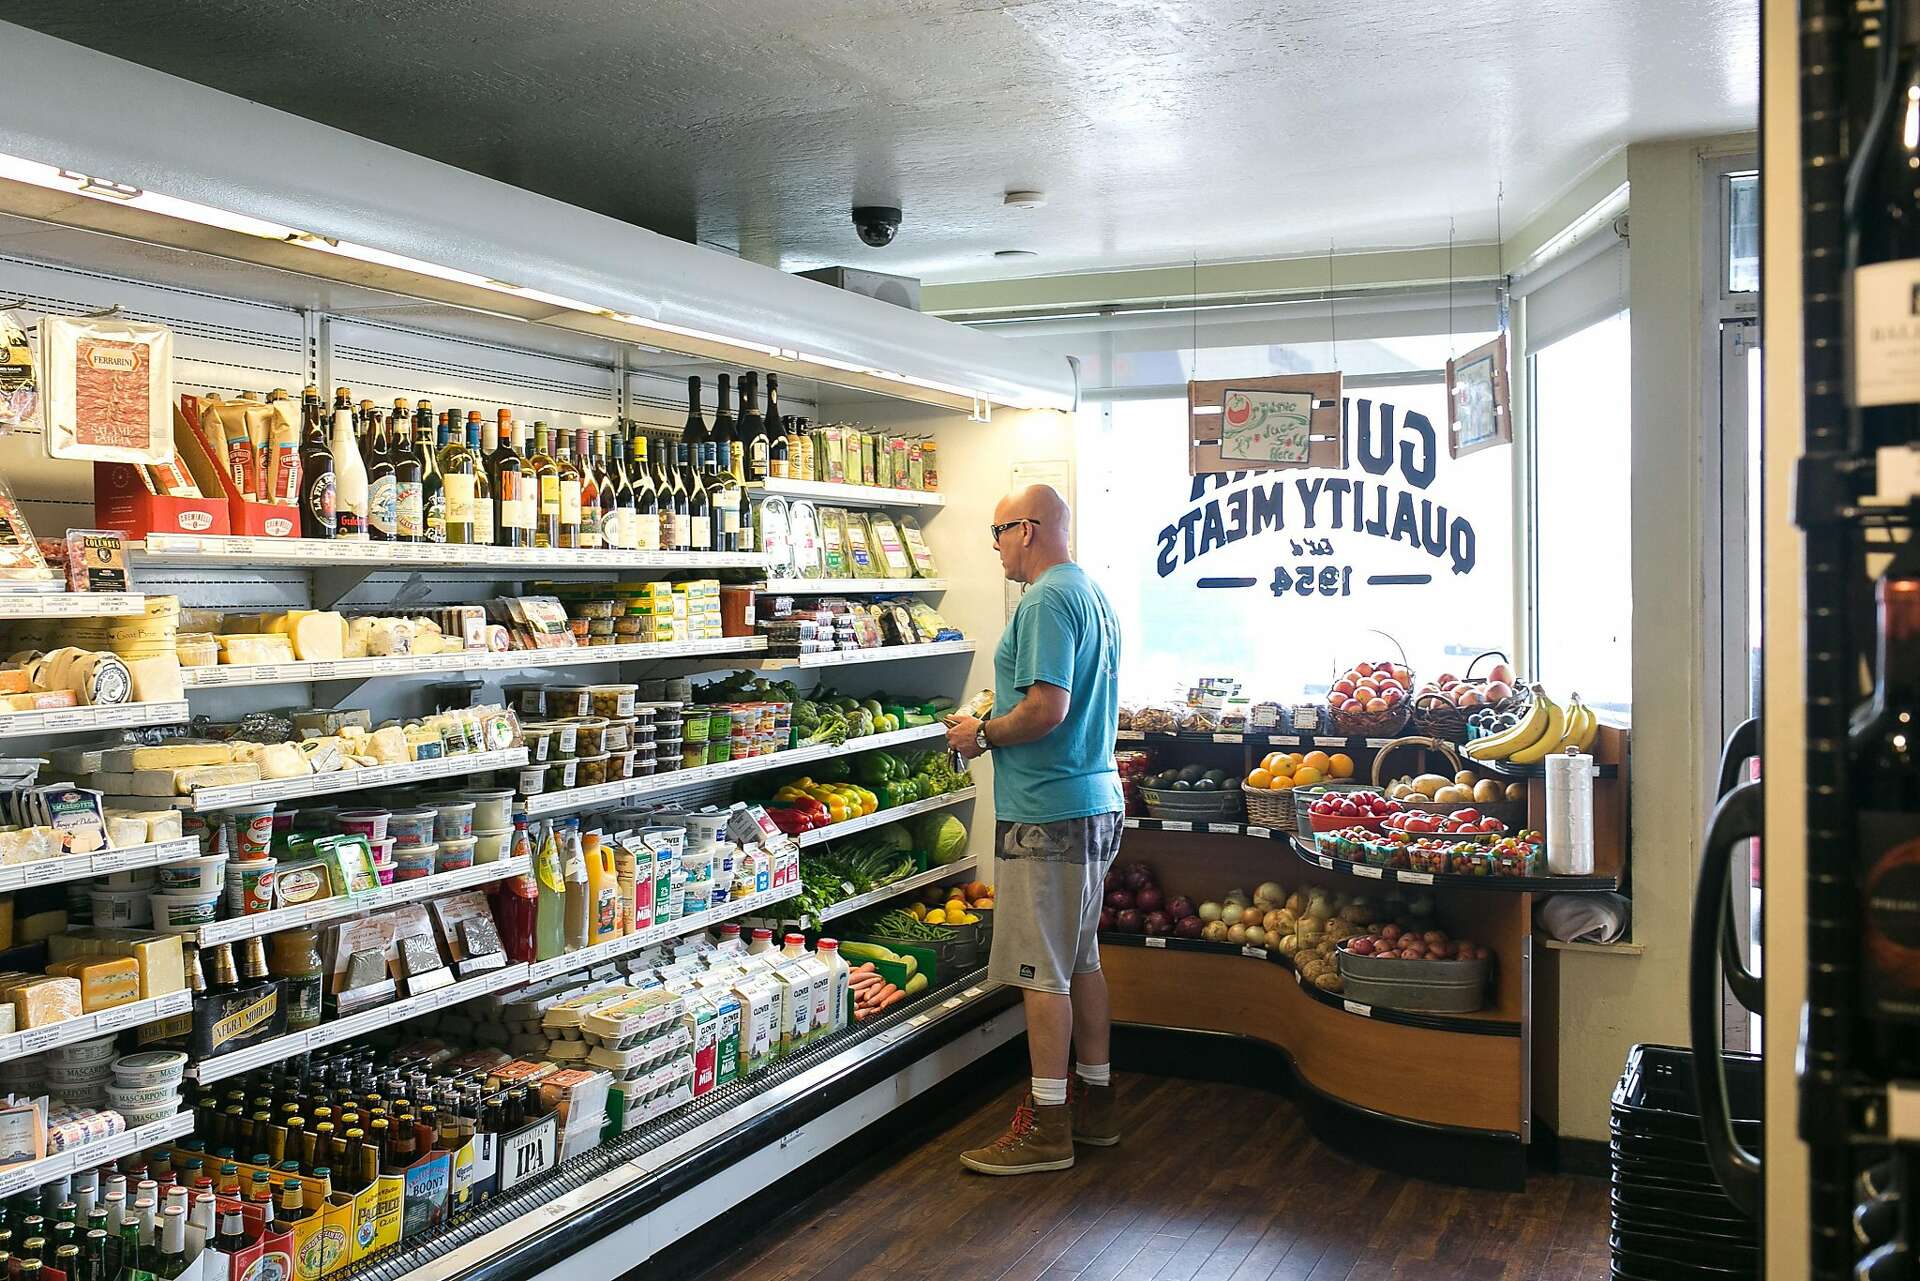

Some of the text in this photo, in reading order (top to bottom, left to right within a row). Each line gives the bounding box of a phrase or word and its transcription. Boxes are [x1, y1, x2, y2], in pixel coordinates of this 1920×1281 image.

[93, 355, 133, 367] FERRARINI
[793, 986, 809, 998] CLOVER
[753, 1003, 770, 1016] CLOVER
[723, 1012, 740, 1024] CLOVER
[700, 1022, 717, 1036] CLOVER
[720, 1060, 737, 1075] Milk
[698, 1072, 713, 1087] Milk
[515, 1138, 545, 1179] IPA
[413, 1174, 445, 1197] BOONT
